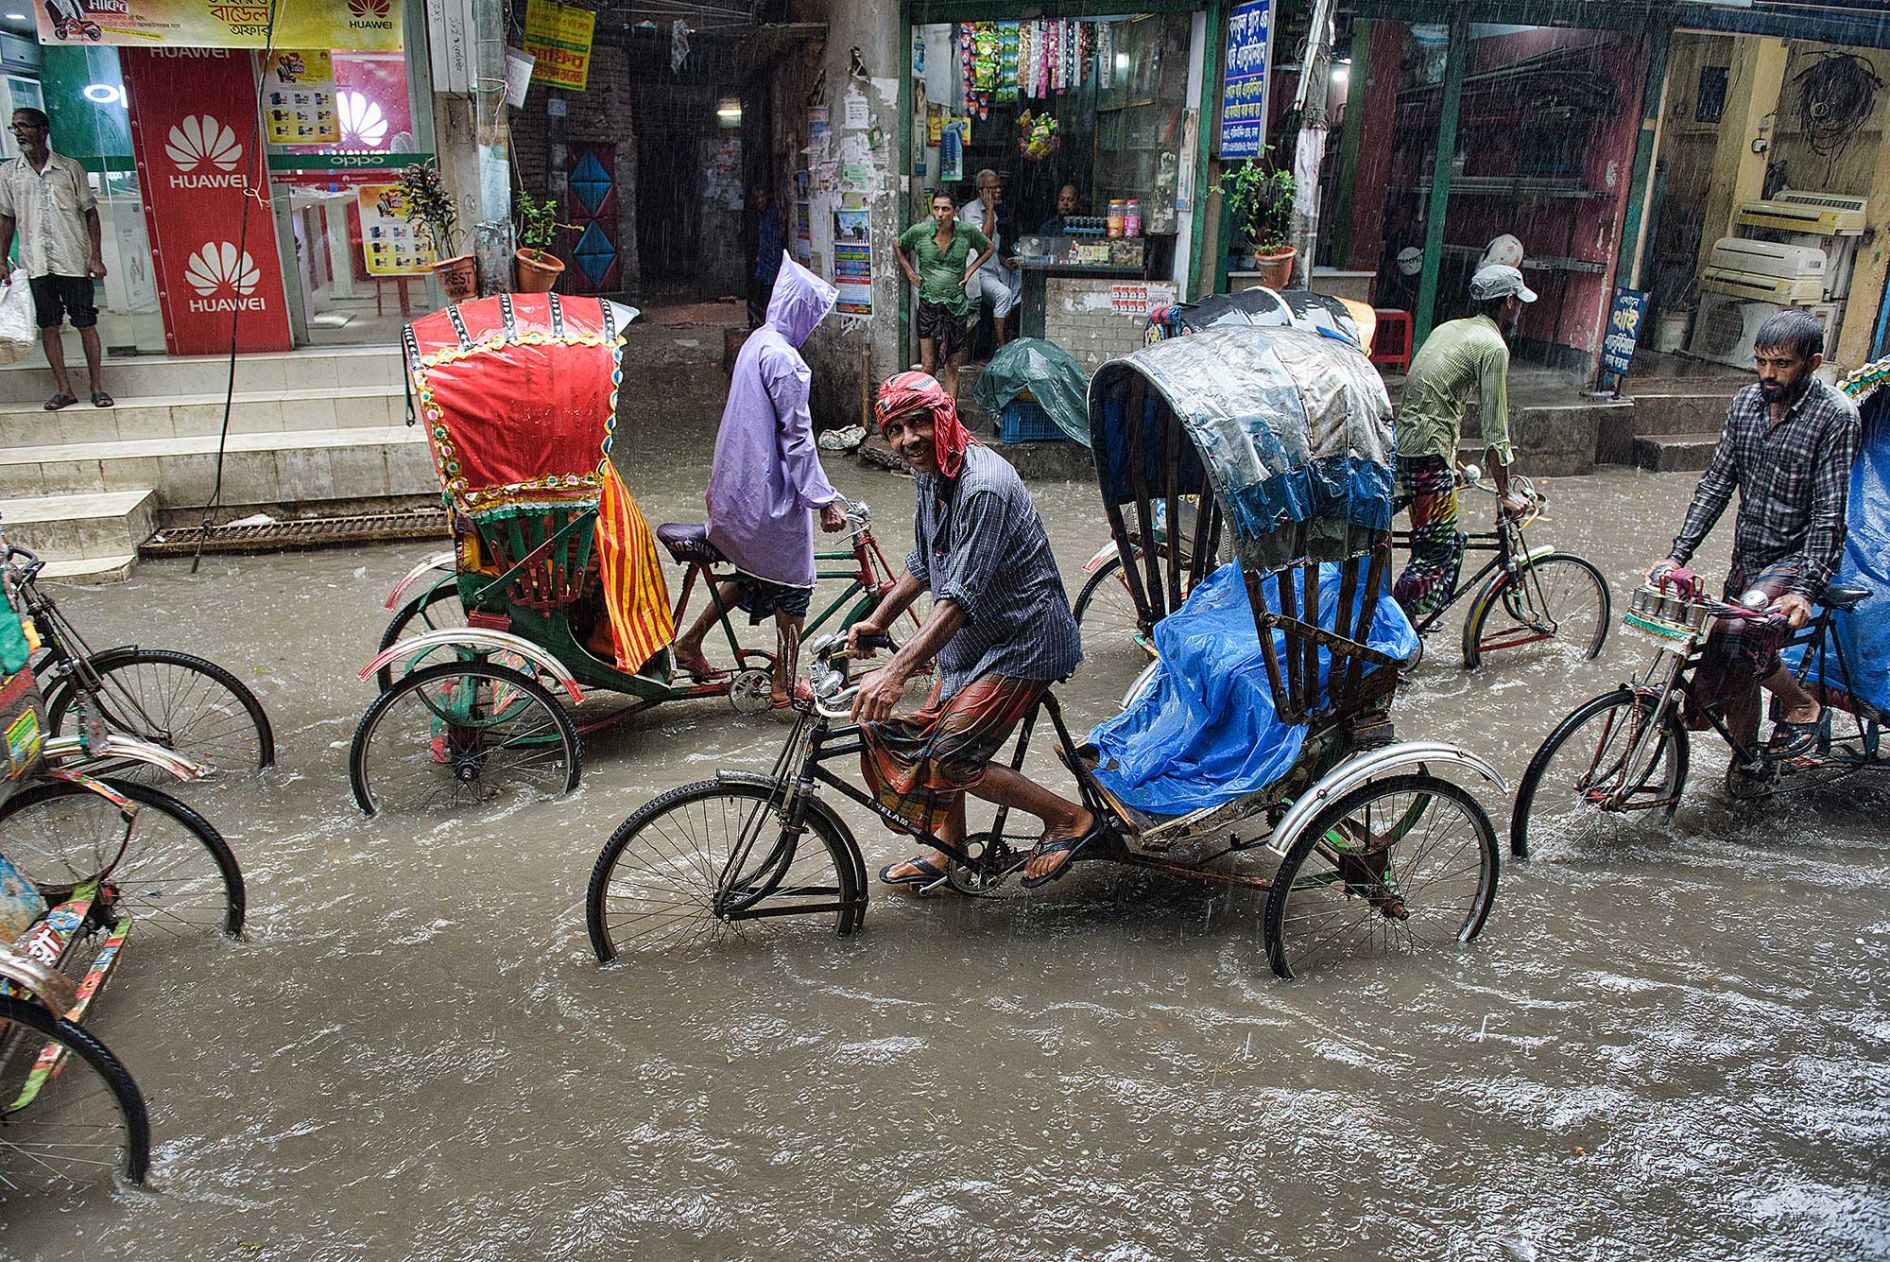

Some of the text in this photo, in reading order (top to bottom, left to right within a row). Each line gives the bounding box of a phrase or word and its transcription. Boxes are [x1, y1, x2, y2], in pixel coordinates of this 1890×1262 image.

[208, 5, 269, 22] বান্ডেল
[350, 20, 392, 29] HUAWEI
[150, 47, 230, 59] HUAWEI
[331, 156, 384, 166] oppo
[170, 175, 249, 189] HUAWEI
[190, 297, 266, 313] HUAWEI
